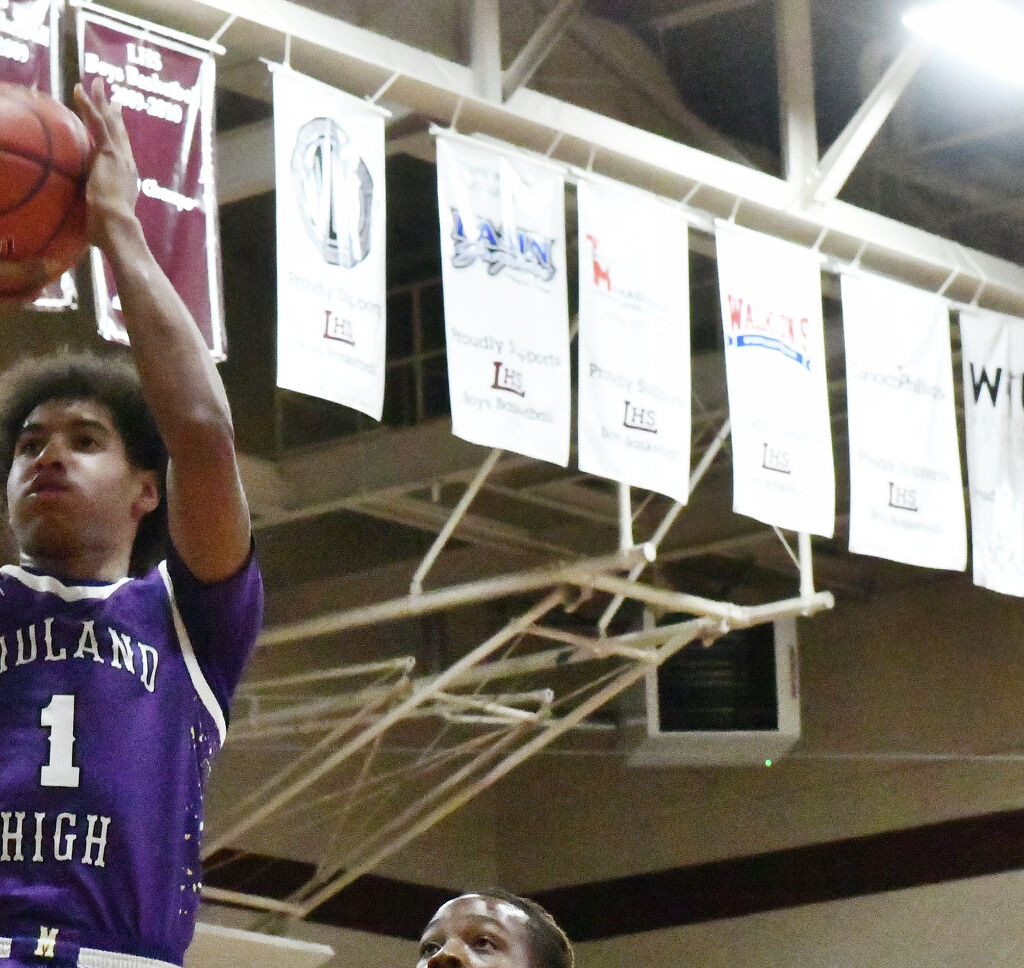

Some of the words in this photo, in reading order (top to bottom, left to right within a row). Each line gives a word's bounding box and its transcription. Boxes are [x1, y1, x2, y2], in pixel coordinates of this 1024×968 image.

[623, 400, 658, 434] LHS
[888, 481, 918, 512] LHS
[40, 694, 80, 787] 1
[0, 811, 111, 867] HIGH
[34, 925, 59, 958] M
